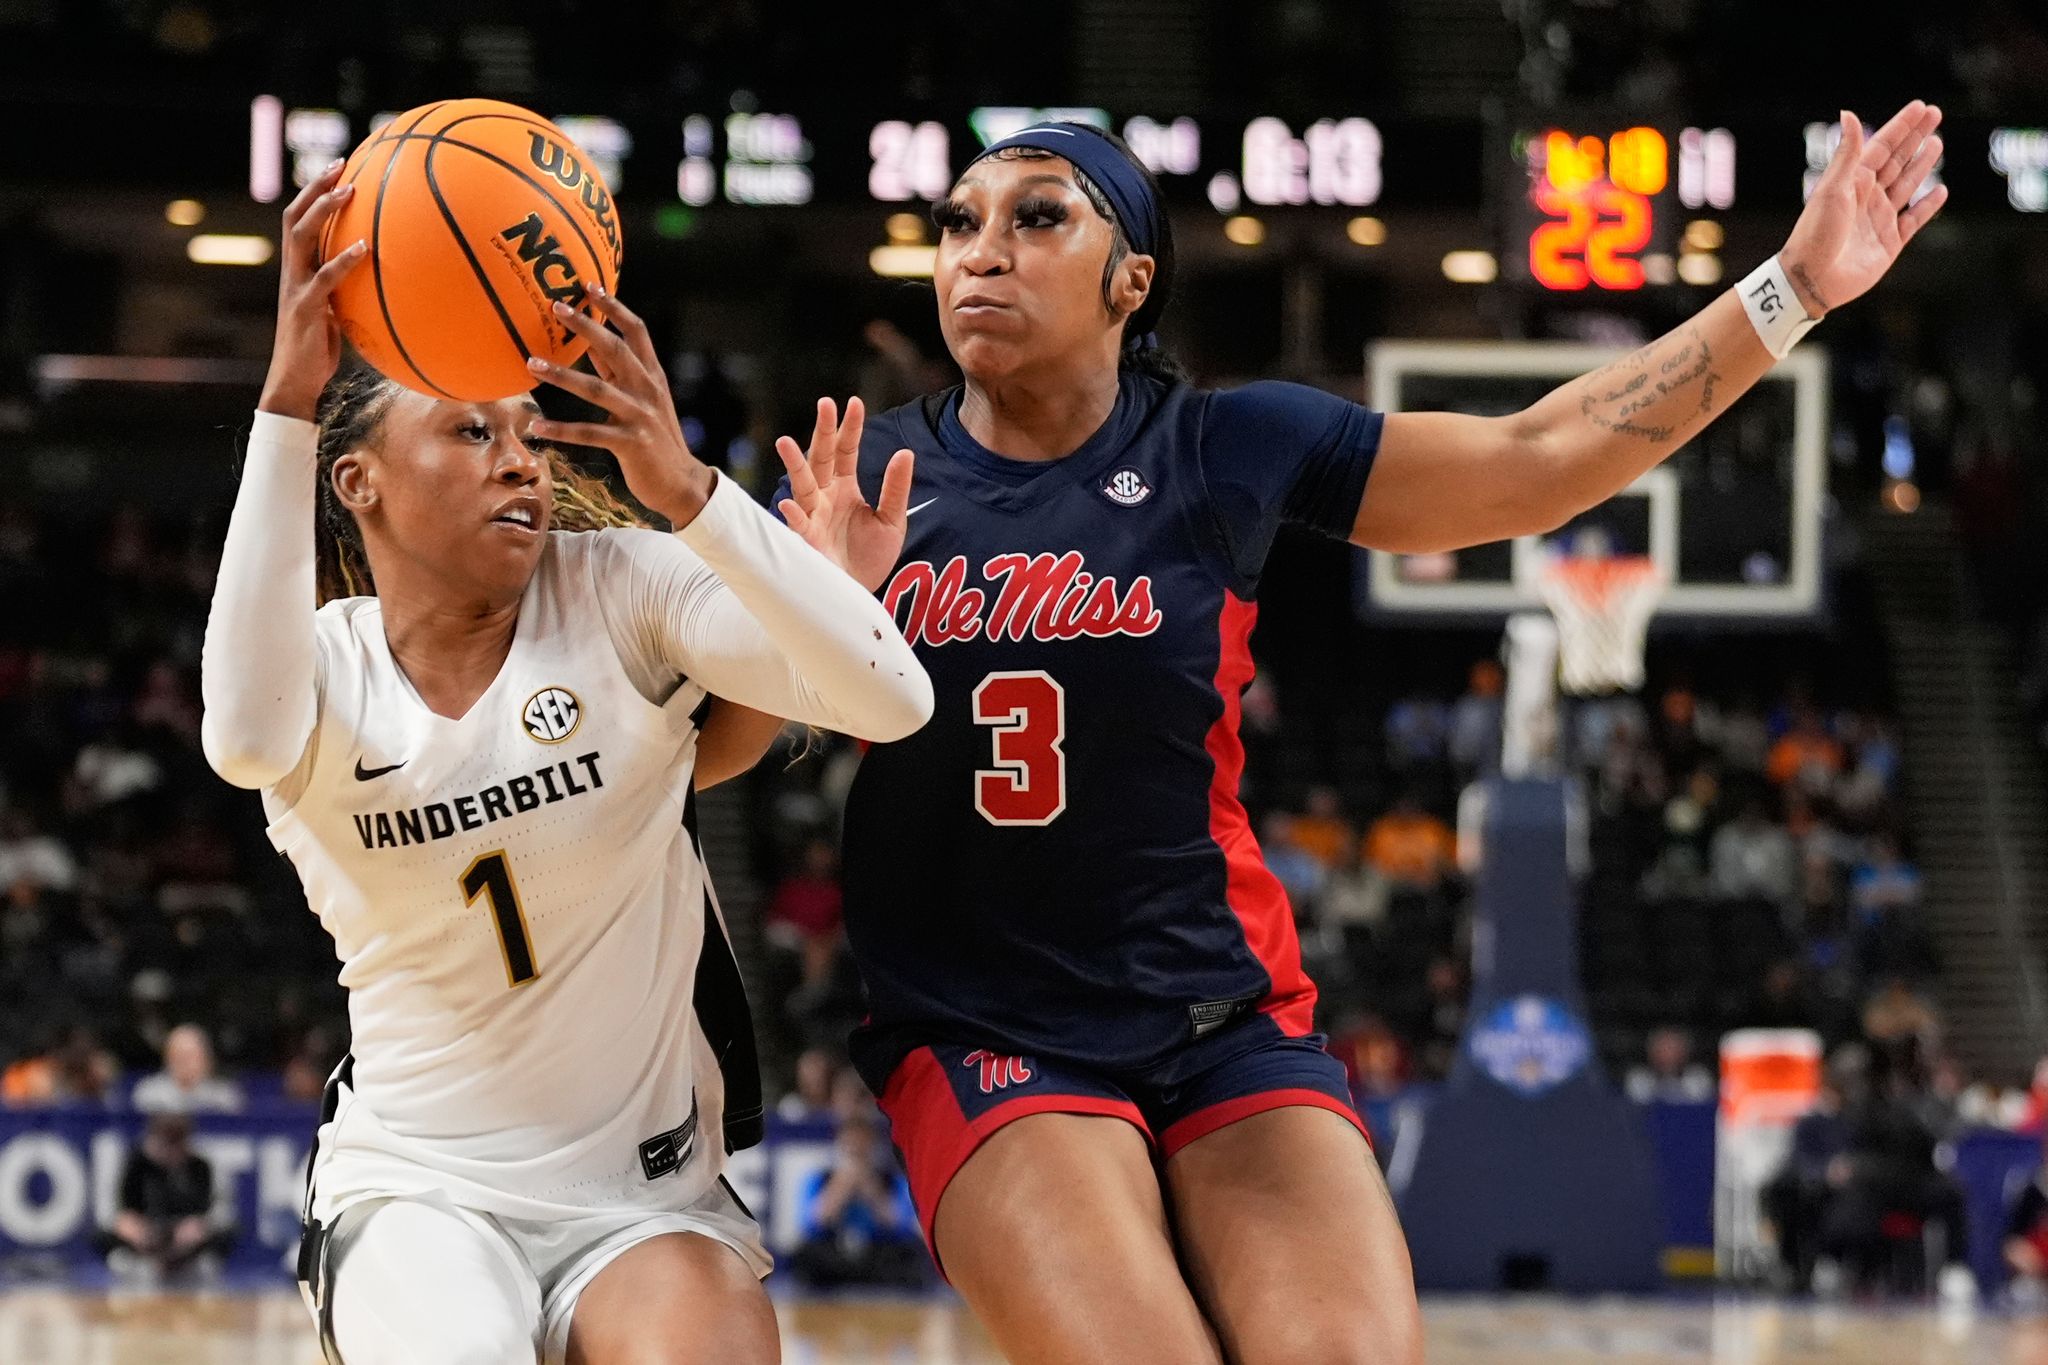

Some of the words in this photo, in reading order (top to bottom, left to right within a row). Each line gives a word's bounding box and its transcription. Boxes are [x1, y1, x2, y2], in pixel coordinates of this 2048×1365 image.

[1529, 178, 1653, 291] 22
[1112, 471, 1140, 496] SEC
[882, 555, 985, 648] Ole
[983, 550, 1163, 642] Miss
[524, 688, 579, 740] SEC
[972, 670, 1066, 827] 3
[352, 751, 604, 849] VANDERBILT
[457, 848, 542, 989] 1
